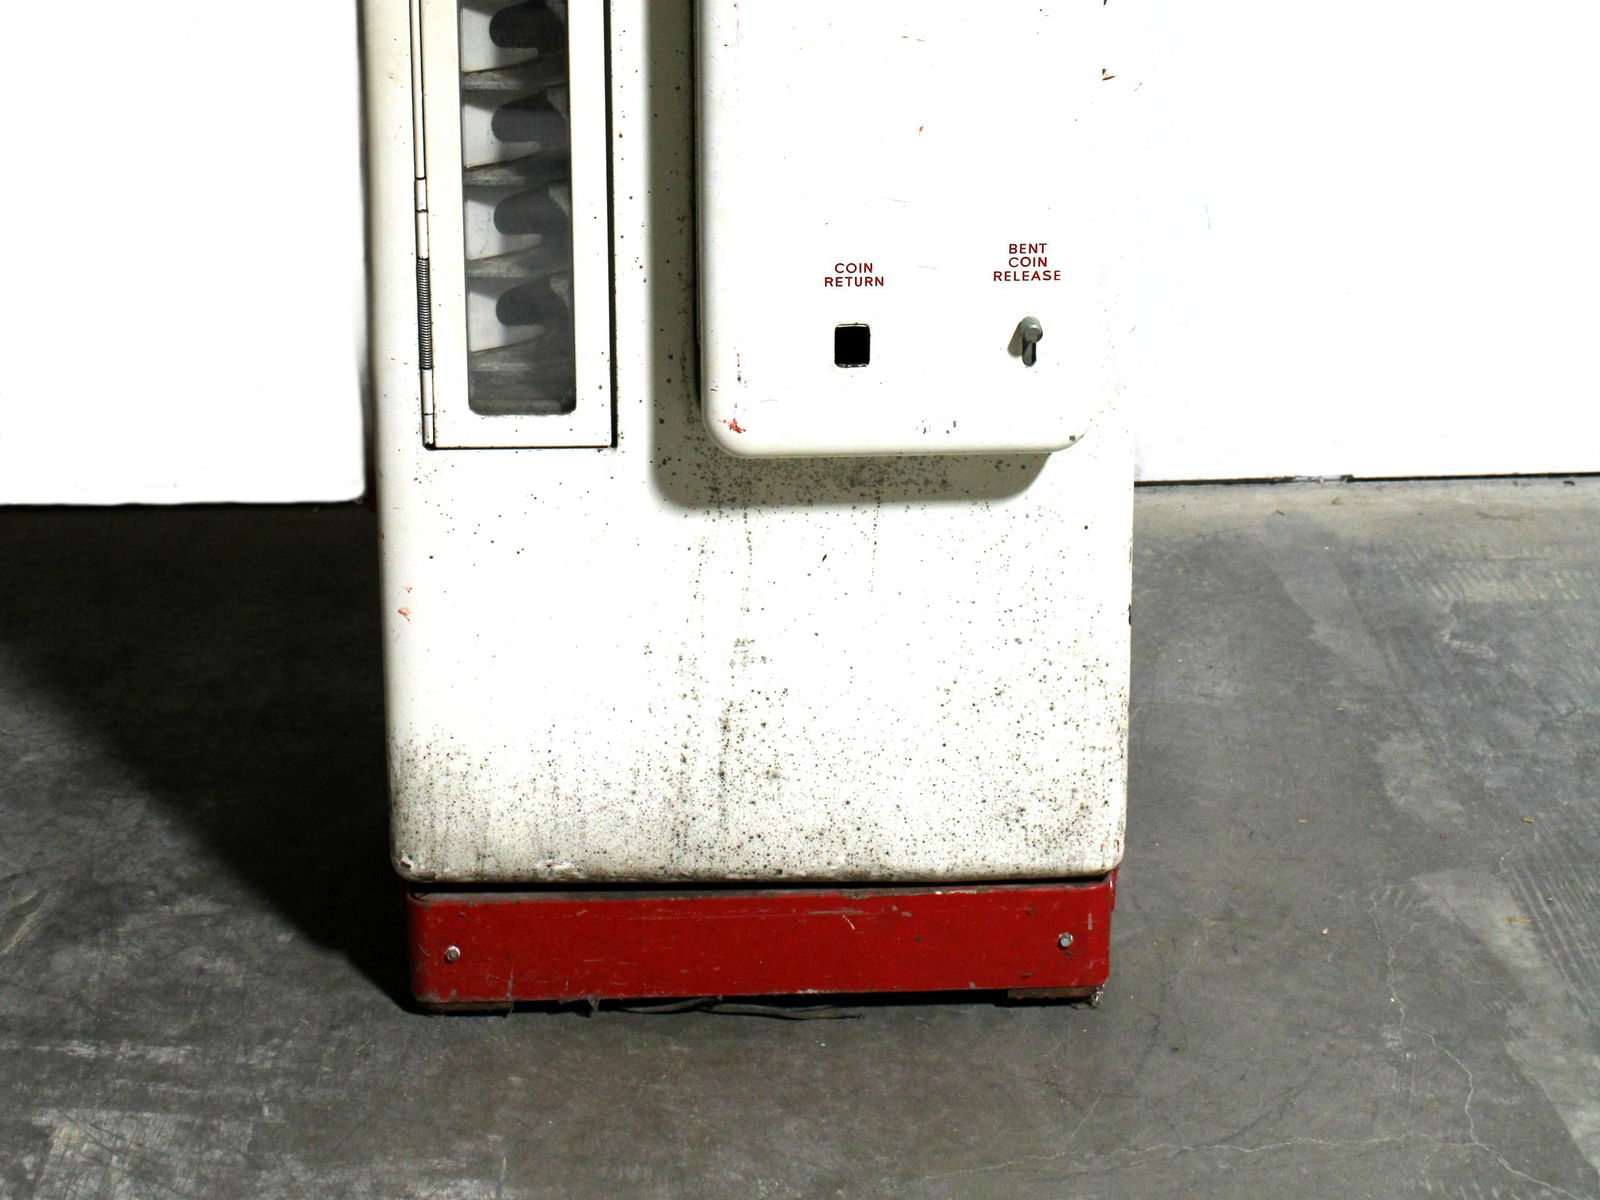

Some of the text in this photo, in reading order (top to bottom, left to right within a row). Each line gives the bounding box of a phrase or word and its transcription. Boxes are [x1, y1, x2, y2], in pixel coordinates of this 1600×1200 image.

[1008, 242, 1048, 255] BENT
[834, 262, 873, 274] COIN
[1008, 256, 1048, 268] COIN
[824, 276, 884, 288] RETURN
[993, 270, 1062, 282] RELEASE
